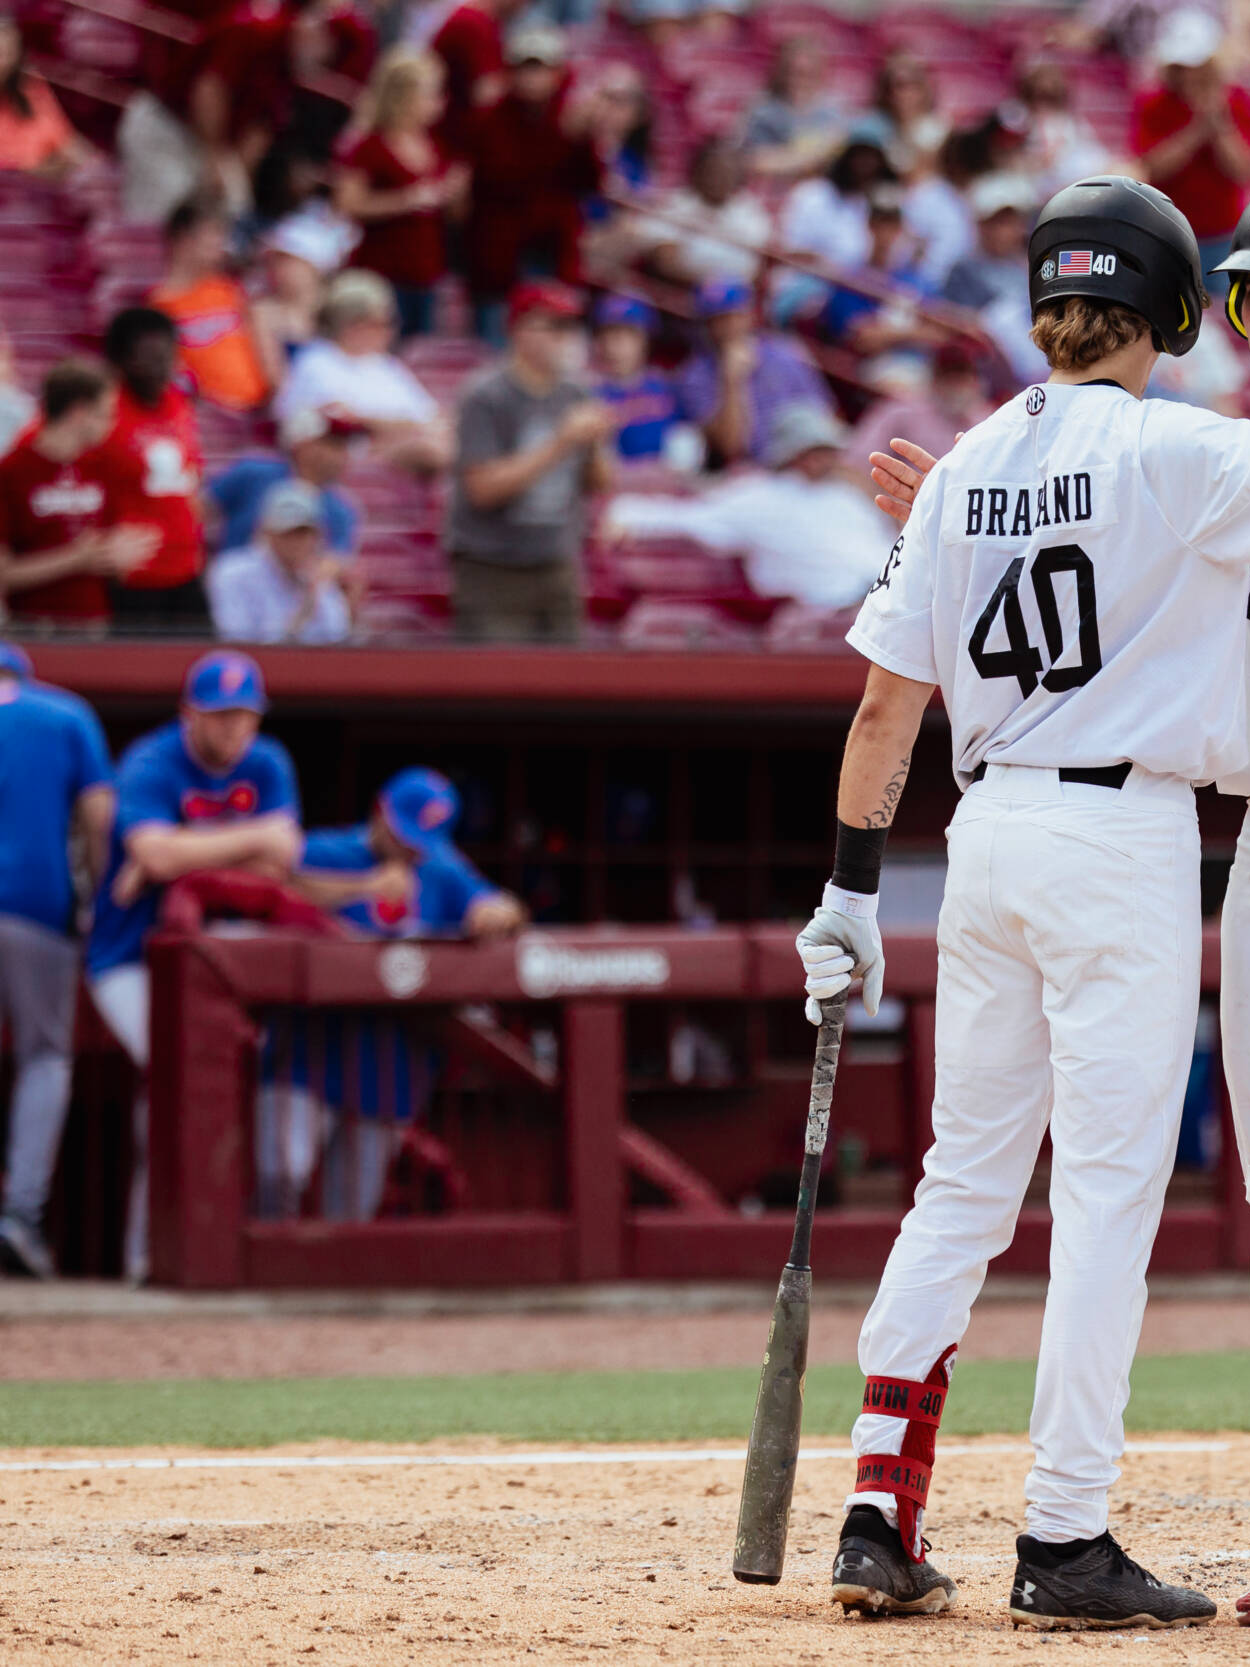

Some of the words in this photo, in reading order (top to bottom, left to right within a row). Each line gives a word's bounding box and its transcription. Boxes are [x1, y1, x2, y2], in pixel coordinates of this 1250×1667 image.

[1042, 261, 1055, 279] SEC
[1093, 254, 1116, 276] 40
[1027, 388, 1045, 414] SEC
[966, 472, 1092, 536] BRAAND
[968, 544, 1102, 700] 40
[918, 1391, 942, 1417] 40
[889, 1465, 927, 1494] 41:10
